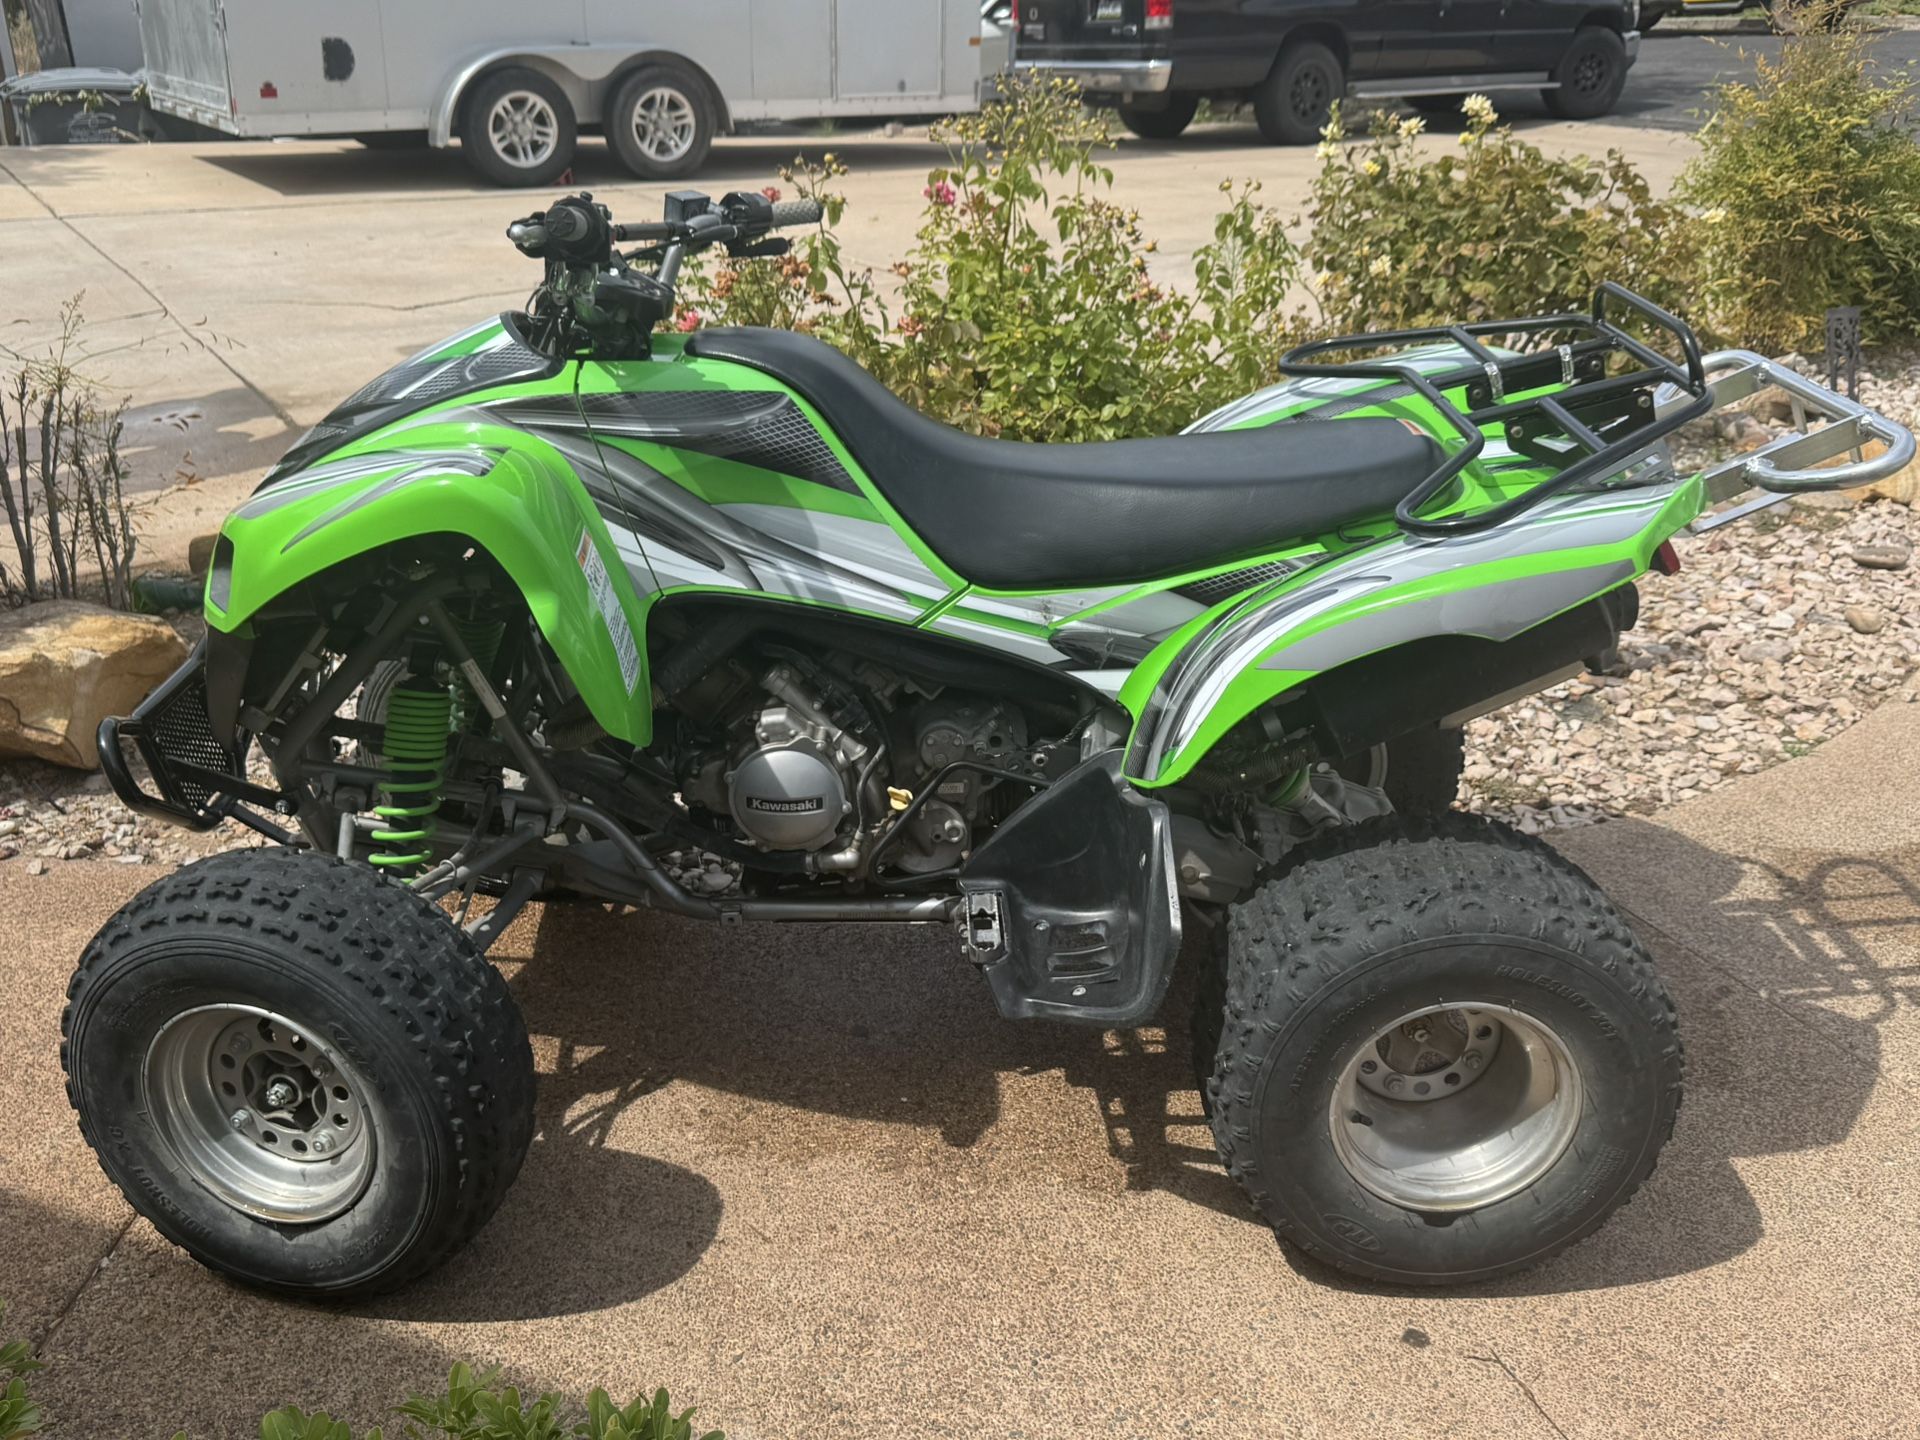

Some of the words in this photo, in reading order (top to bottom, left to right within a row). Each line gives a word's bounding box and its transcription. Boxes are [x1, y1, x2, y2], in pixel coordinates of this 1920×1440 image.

[752, 798, 817, 811] Kawasaki
[1494, 964, 1594, 1010] HOLESHOT
[128, 1165, 213, 1239] HOLESHOT
